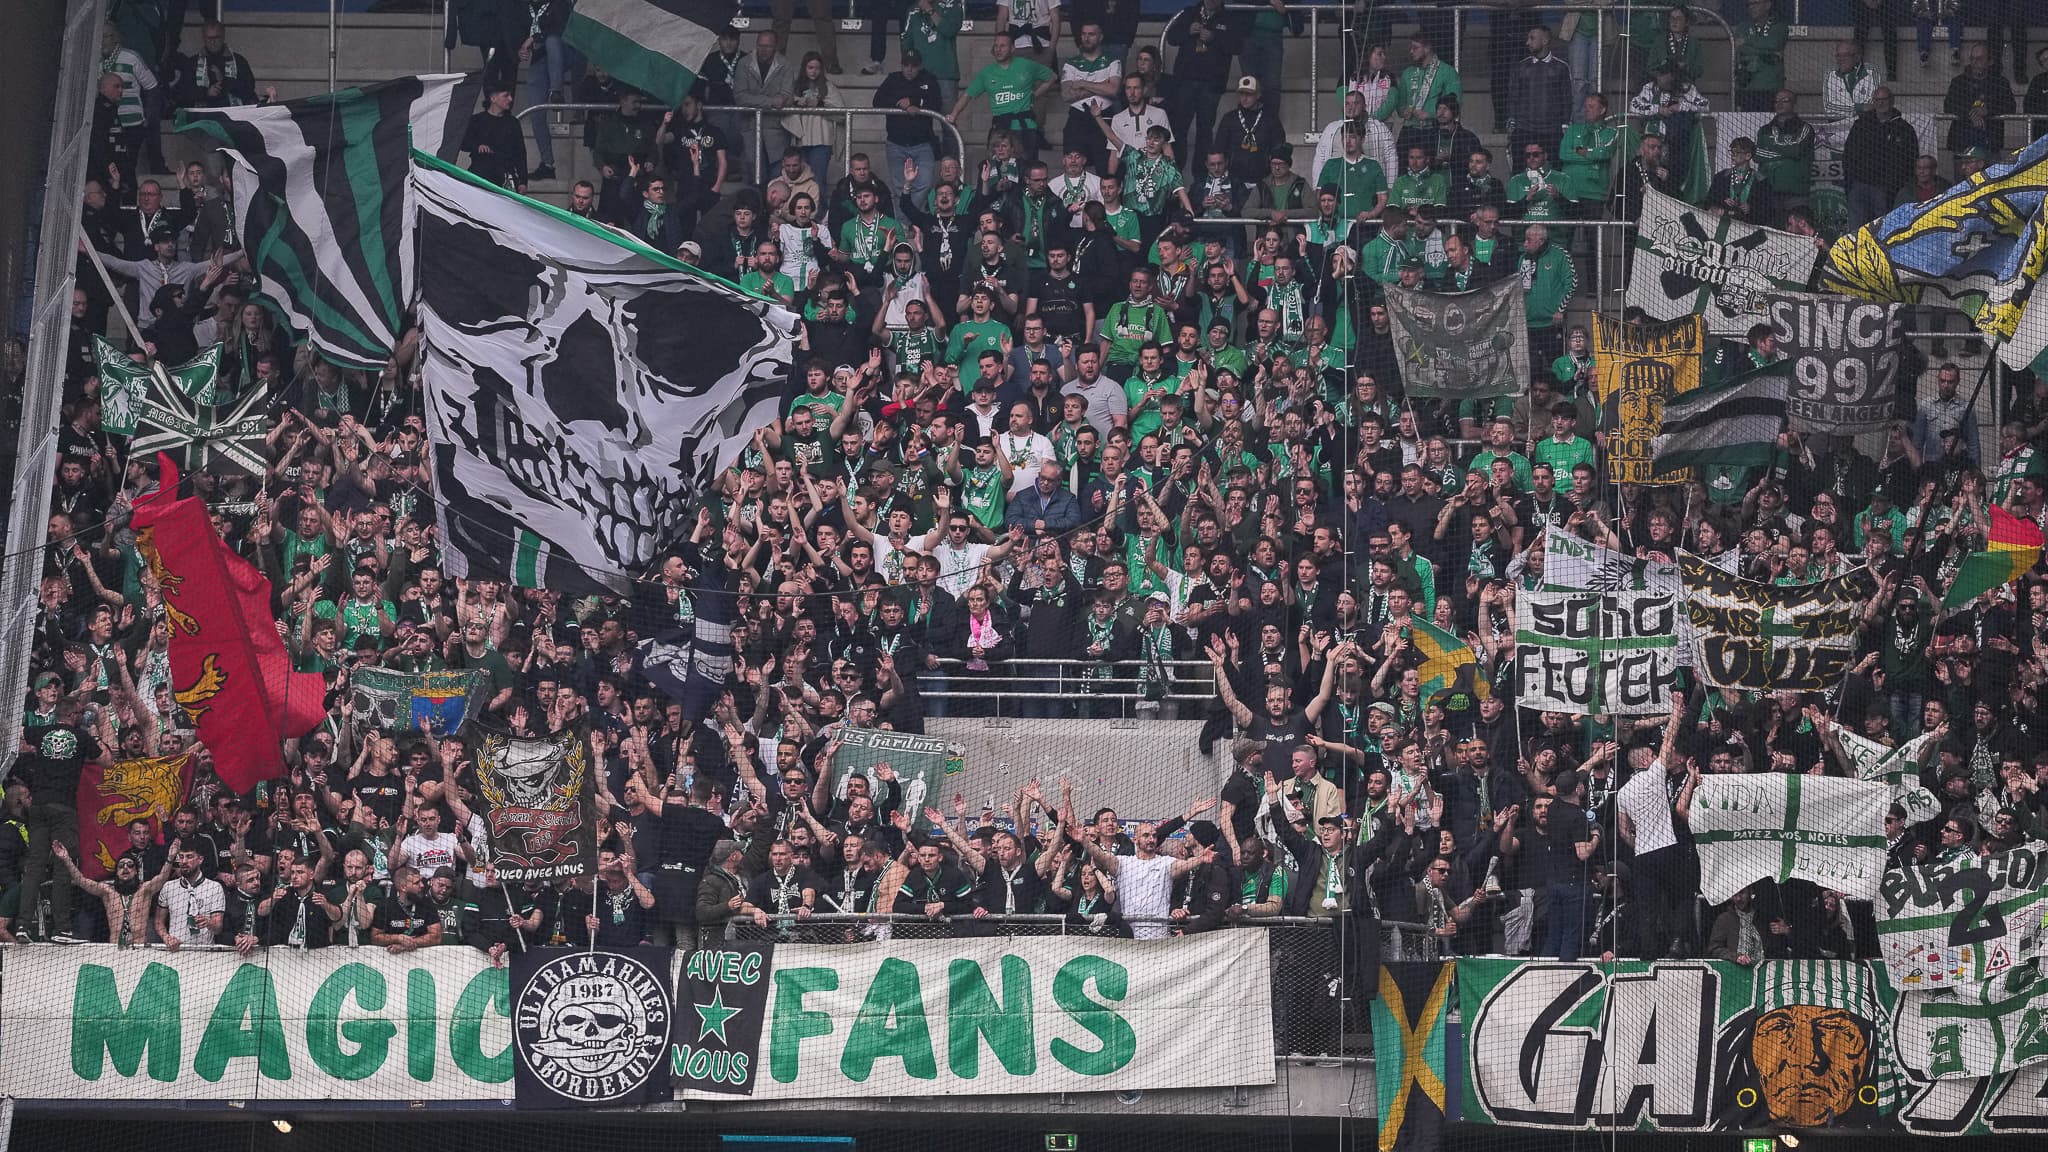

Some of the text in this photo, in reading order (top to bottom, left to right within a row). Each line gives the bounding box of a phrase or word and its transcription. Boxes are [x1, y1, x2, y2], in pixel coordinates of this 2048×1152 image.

[1771, 301, 1902, 348] SINCE
[1778, 350, 1900, 403] 992
[1698, 784, 1774, 814] VIDA
[1733, 830, 1848, 845] PAYEZ VOS NOTES
[555, 863, 585, 877] NOUS
[687, 950, 762, 985] AVEC
[519, 956, 664, 1029] ULTRAMARINES
[569, 983, 614, 999] 1987
[71, 954, 1137, 1084] MAGIC FANS
[539, 1047, 656, 1098] BORDEAUX
[671, 1043, 750, 1086] NOUS
